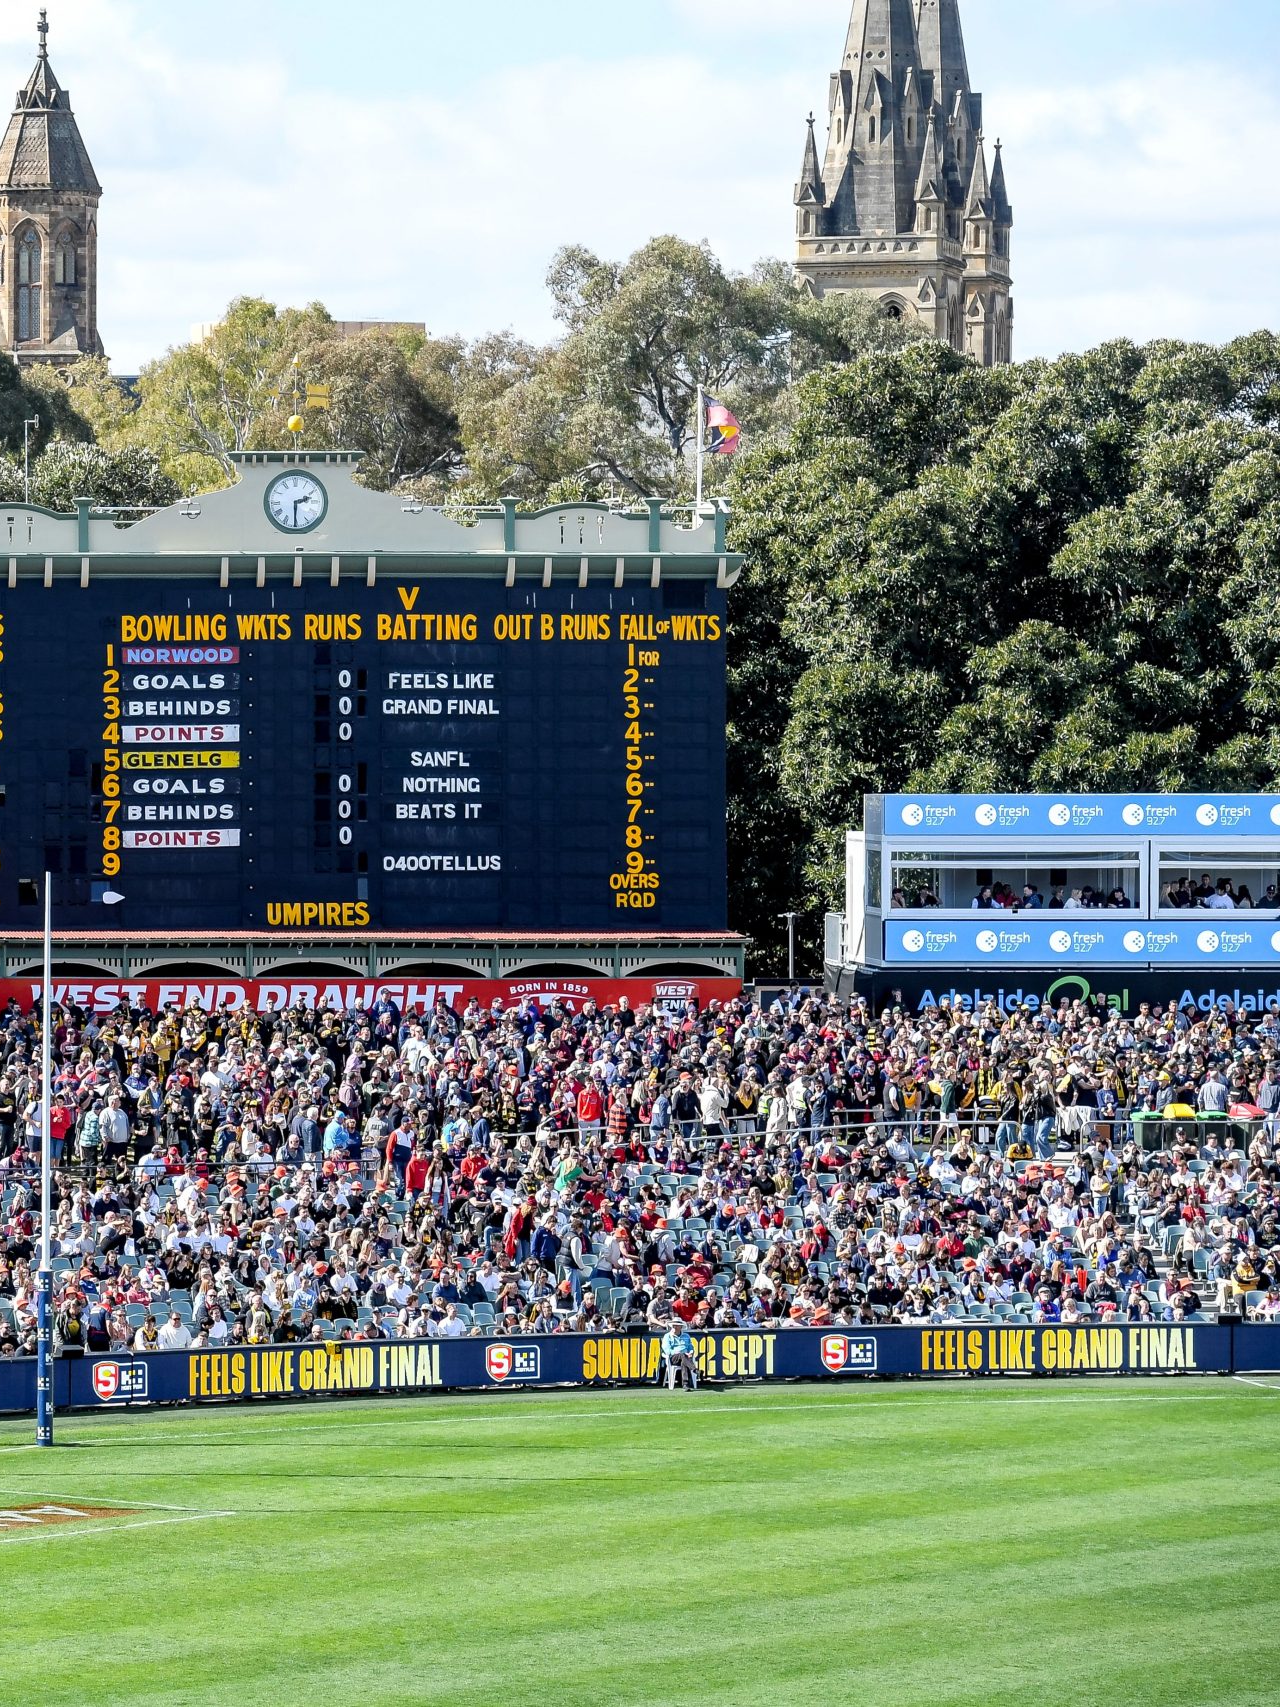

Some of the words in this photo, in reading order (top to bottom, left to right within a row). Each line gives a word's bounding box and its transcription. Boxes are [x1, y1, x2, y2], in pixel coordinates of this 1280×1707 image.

[398, 587, 419, 610] V
[121, 615, 226, 642] BOWLING
[237, 614, 291, 640] WKTS
[304, 614, 361, 640] RUNS
[377, 614, 477, 640] BATTING
[493, 614, 533, 640] OUT
[541, 614, 554, 640] B
[561, 614, 611, 640] RUNS
[620, 614, 657, 640] FALL
[671, 615, 721, 641] WKTS
[107, 644, 113, 667] 1
[127, 648, 233, 663] NORWOOD
[629, 643, 635, 666] 1
[638, 651, 659, 666] FOR
[103, 670, 119, 693] 2
[132, 674, 225, 690] GOALS
[388, 673, 449, 689] FEELS
[453, 673, 494, 689] LIKE
[623, 668, 639, 692] 2
[103, 697, 119, 719] 3
[128, 700, 231, 716] BEHINDS
[382, 699, 442, 715] GRAND
[447, 699, 500, 715] FINAL
[624, 696, 640, 718] 3
[103, 723, 119, 744] 4
[135, 726, 225, 741] POINTS
[624, 722, 642, 743] 4
[103, 749, 119, 771] 5
[127, 753, 222, 767] GLENELG
[411, 751, 470, 767] SANFL
[625, 747, 641, 770] 5
[103, 774, 119, 795] 6
[132, 778, 225, 794] GOALS
[402, 777, 480, 794] NOTHING
[625, 773, 643, 796] 6
[103, 801, 119, 823] 7
[127, 804, 234, 820] BEHINDS
[396, 804, 455, 819] BEATS
[465, 804, 482, 819] IT
[626, 800, 642, 822] 7
[925, 804, 956, 816] fresh
[999, 804, 1030, 816] fresh
[1072, 804, 1103, 816] fresh
[1146, 804, 1177, 816] fresh
[1220, 804, 1251, 816] fresh
[103, 827, 119, 849] 8
[134, 832, 221, 846] POINTS
[625, 827, 643, 848] 8
[103, 852, 119, 876] 9
[626, 852, 644, 874] 9
[610, 873, 659, 889] OVERS
[267, 903, 370, 926] UMPIRES
[926, 931, 957, 942] fresh
[1000, 931, 1031, 942] fresh
[1073, 932, 1104, 943] fresh
[1147, 932, 1178, 943] fresh
[1221, 932, 1252, 943] fresh
[157, 985, 246, 1012] END
[509, 982, 541, 995] BORN
[545, 982, 558, 990] IN
[562, 983, 589, 995] 1859
[655, 985, 696, 995] WEST
[583, 1337, 660, 1379] SUNDA
[722, 1334, 776, 1376] SEPT
[922, 1330, 983, 1371] FEELS
[988, 1330, 1036, 1370] LIKE
[1041, 1328, 1123, 1369] GRAND
[1129, 1327, 1197, 1368] FINAL
[189, 1352, 245, 1396] FEELS
[250, 1350, 294, 1393] LIKE
[299, 1346, 374, 1391] GRAND
[379, 1344, 442, 1387] FINAL
